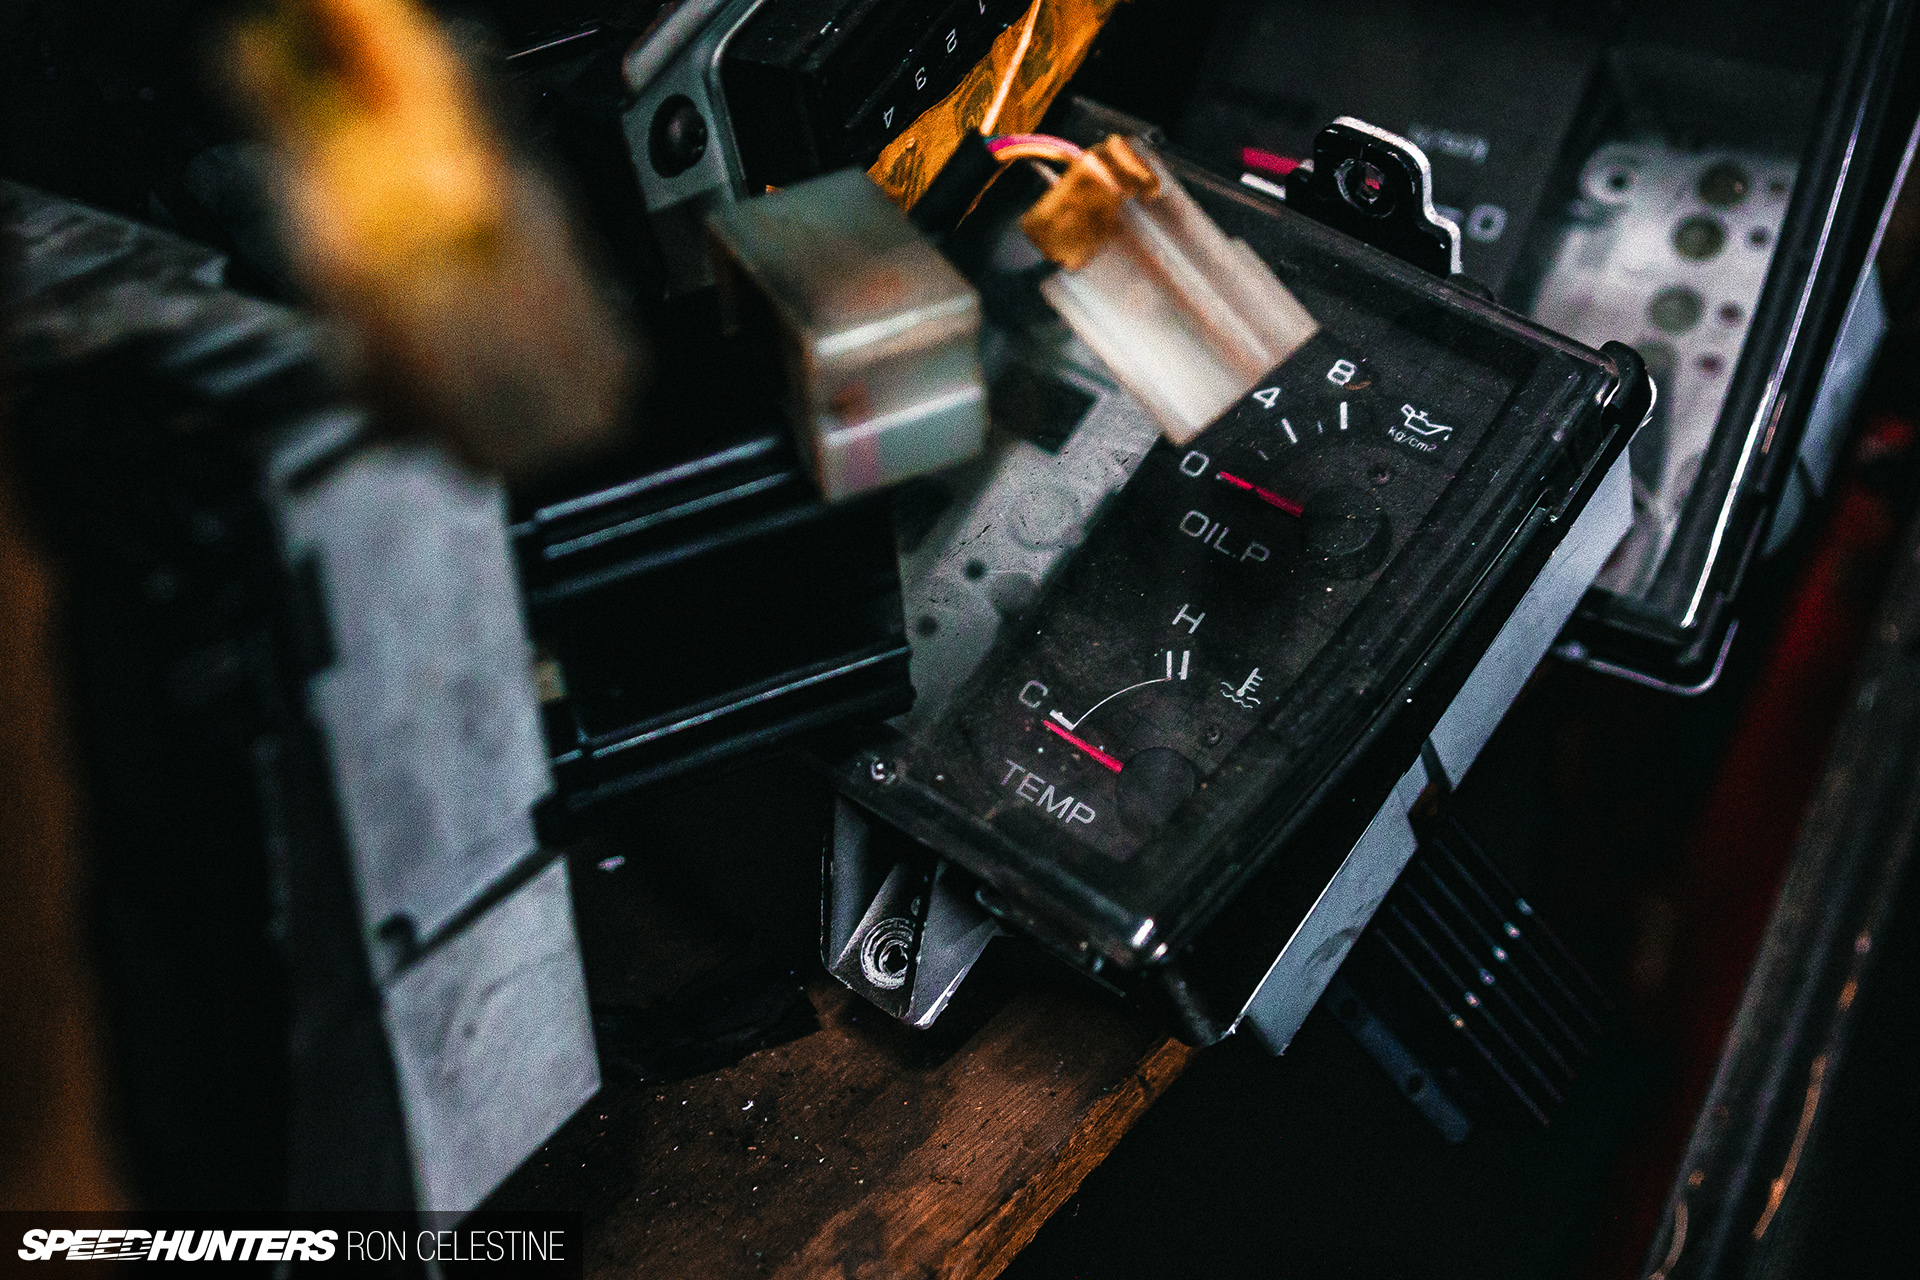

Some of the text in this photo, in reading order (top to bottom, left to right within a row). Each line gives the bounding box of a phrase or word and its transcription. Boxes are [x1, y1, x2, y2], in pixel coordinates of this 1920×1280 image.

[1327, 359, 1356, 386] 8
[1253, 386, 1281, 409] 4
[1172, 603, 1206, 634] H
[1018, 679, 1049, 709] C
[1000, 758, 1096, 825] TEMP
